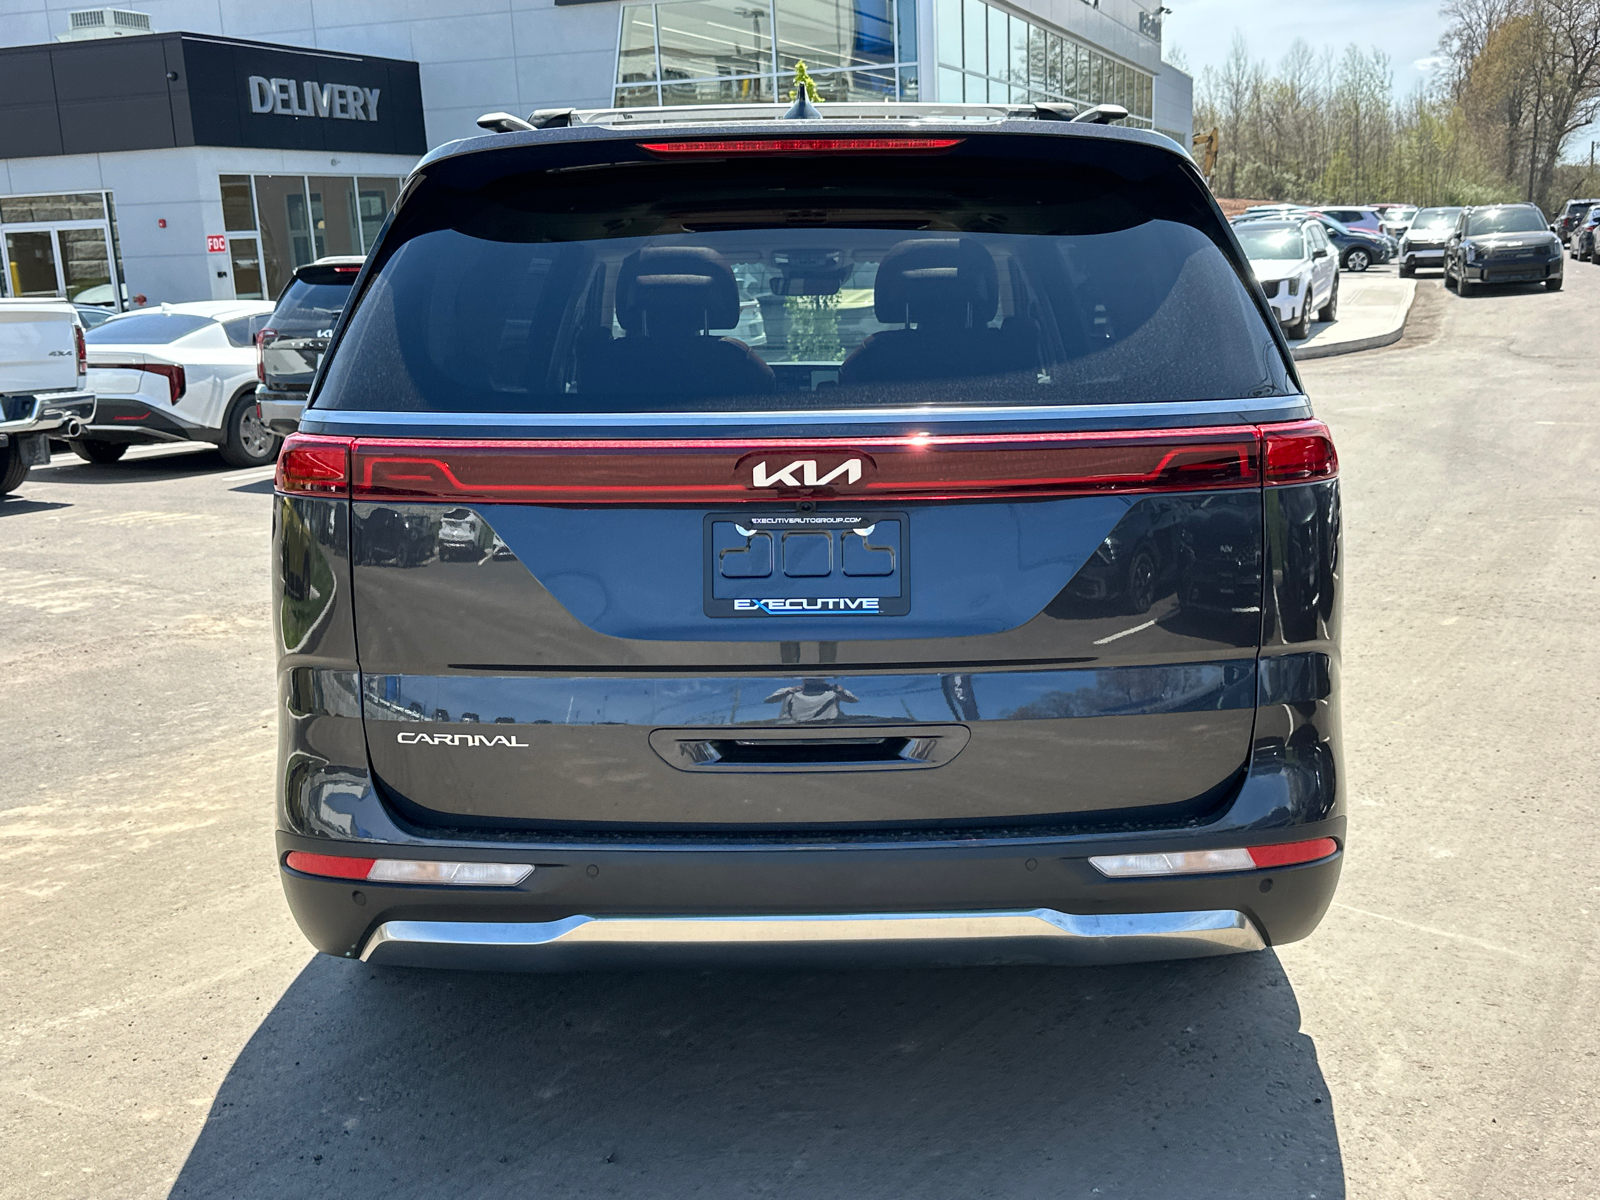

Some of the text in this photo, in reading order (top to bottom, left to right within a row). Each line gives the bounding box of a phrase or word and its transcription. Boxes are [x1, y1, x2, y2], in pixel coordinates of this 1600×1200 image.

[248, 75, 381, 121] DELIVERY
[208, 237, 225, 250] FDC
[316, 329, 334, 338] KI
[752, 458, 862, 487] KIA
[734, 598, 880, 614] EXECUTIVE
[397, 732, 529, 747] CARNIVAL
